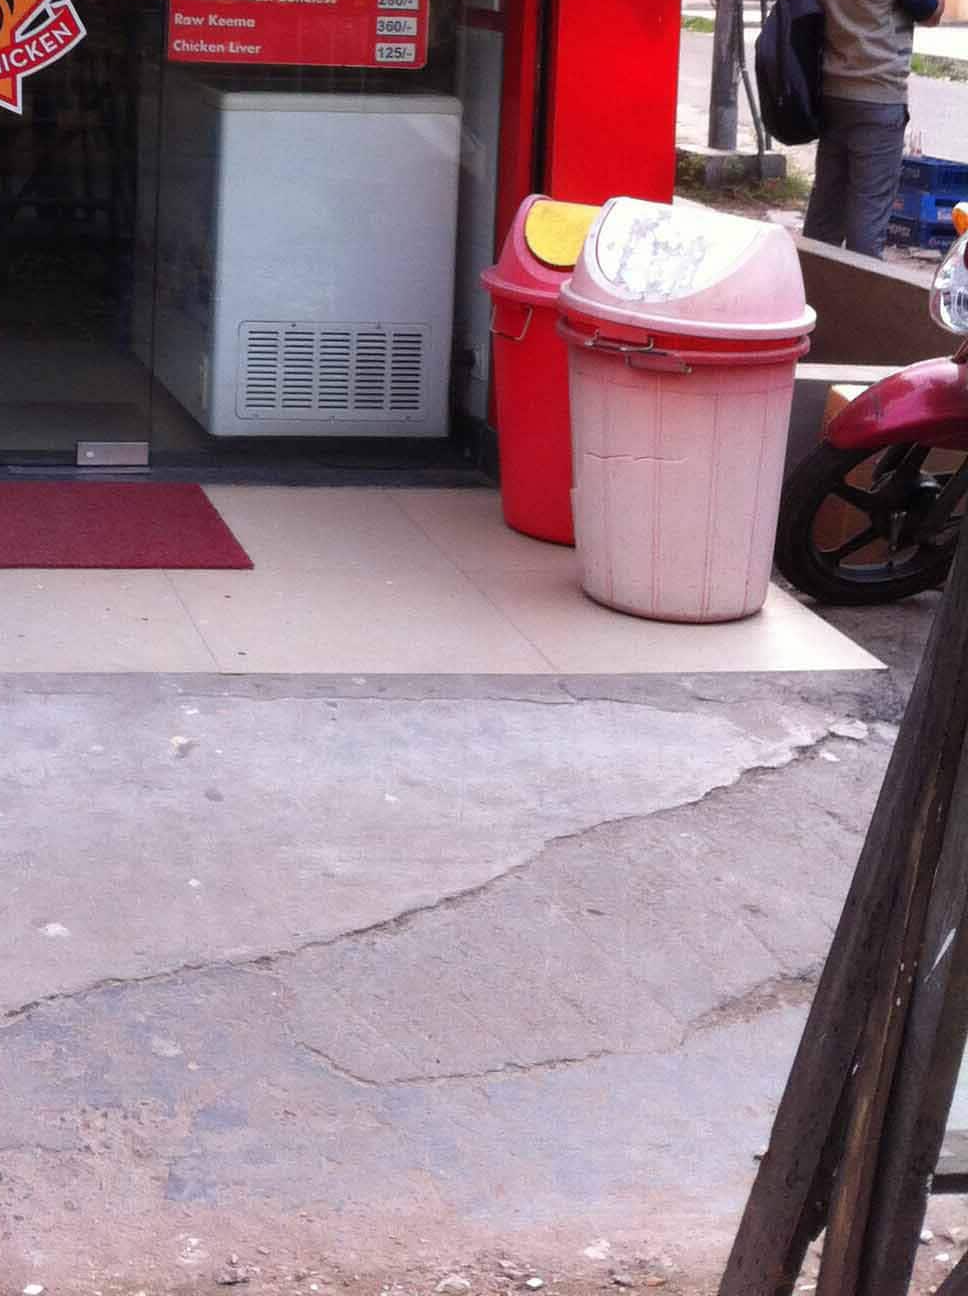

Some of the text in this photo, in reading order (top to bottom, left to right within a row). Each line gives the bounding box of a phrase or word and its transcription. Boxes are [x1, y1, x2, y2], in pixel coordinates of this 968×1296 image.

[174, 13, 255, 29] Raw Keema
[377, 21, 412, 34] 360/-
[173, 40, 262, 55] Chicken Liver
[377, 47, 413, 61] 125/-
